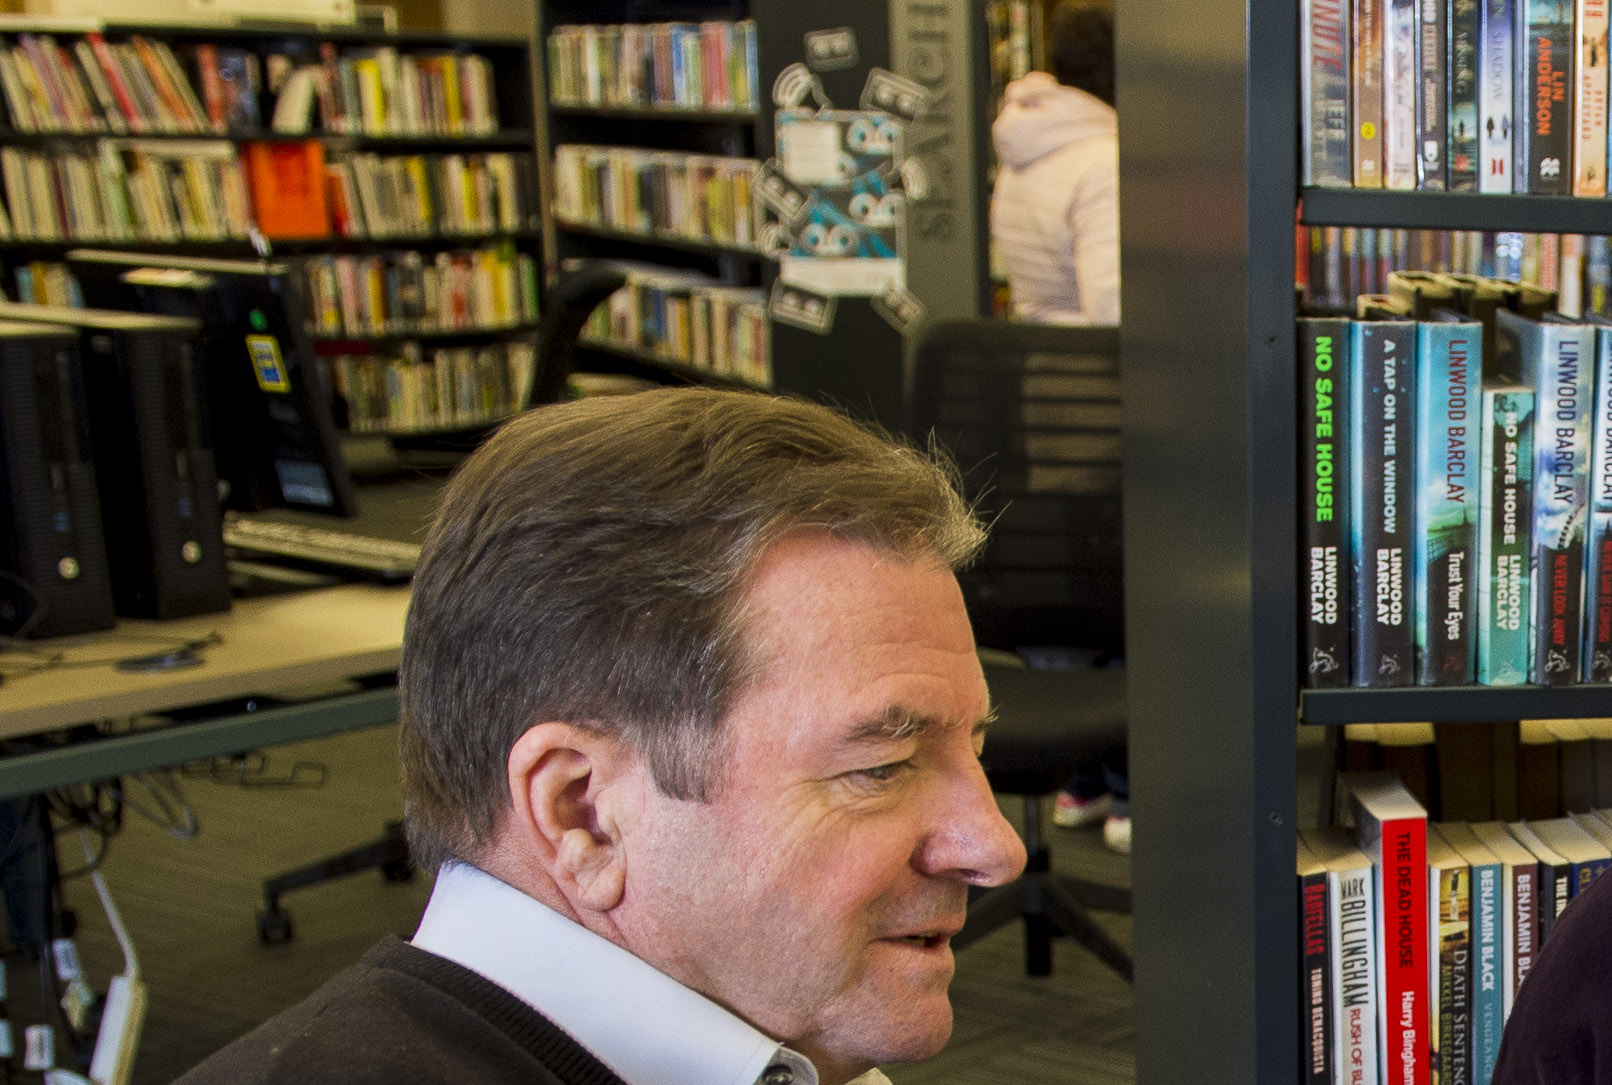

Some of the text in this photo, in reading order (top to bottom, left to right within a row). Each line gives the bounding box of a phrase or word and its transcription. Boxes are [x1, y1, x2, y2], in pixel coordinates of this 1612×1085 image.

[1536, 37, 1552, 136] ANDERSON
[1552, 71, 1565, 102] LIN
[1315, 336, 1333, 522] NO SAFE HOUSE
[1383, 340, 1396, 534] A TAP ON THE WINDOW
[1446, 340, 1467, 504] LINWOOD BARCLAY
[1554, 341, 1579, 504] LINWOOD BARCLAY
[1503, 411, 1517, 545] NO SAFE HOUSE
[1310, 546, 1324, 624] BARCLAY
[1325, 546, 1337, 625] LINWOOD
[1376, 548, 1390, 625] BARCLAY
[1390, 547, 1403, 626] LINWOOD
[1445, 551, 1464, 640] Trust Your Eyes
[1496, 555, 1509, 630] BARCLAY
[1508, 554, 1521, 630] LINWOOD
[1552, 555, 1567, 645] NEVER LOOK AWAY
[1305, 883, 1325, 956] BADFELLAS
[1340, 877, 1365, 898] MARK
[1396, 832, 1414, 968] THE DEAD HOUSE
[1517, 874, 1531, 953] BENJAMIN
[1556, 876, 1569, 898] THE
[1341, 900, 1370, 1008] BILLINGHAM
[1440, 964, 1453, 1009] MIKKEL
[1453, 949, 1469, 1006] DEATH
[1480, 869, 1495, 1080] BENJAMIN BLACK VENGEANCE
[1350, 1009, 1364, 1047] RUSH
[1399, 990, 1416, 1027] Harry
[1352, 1048, 1364, 1065] OF
